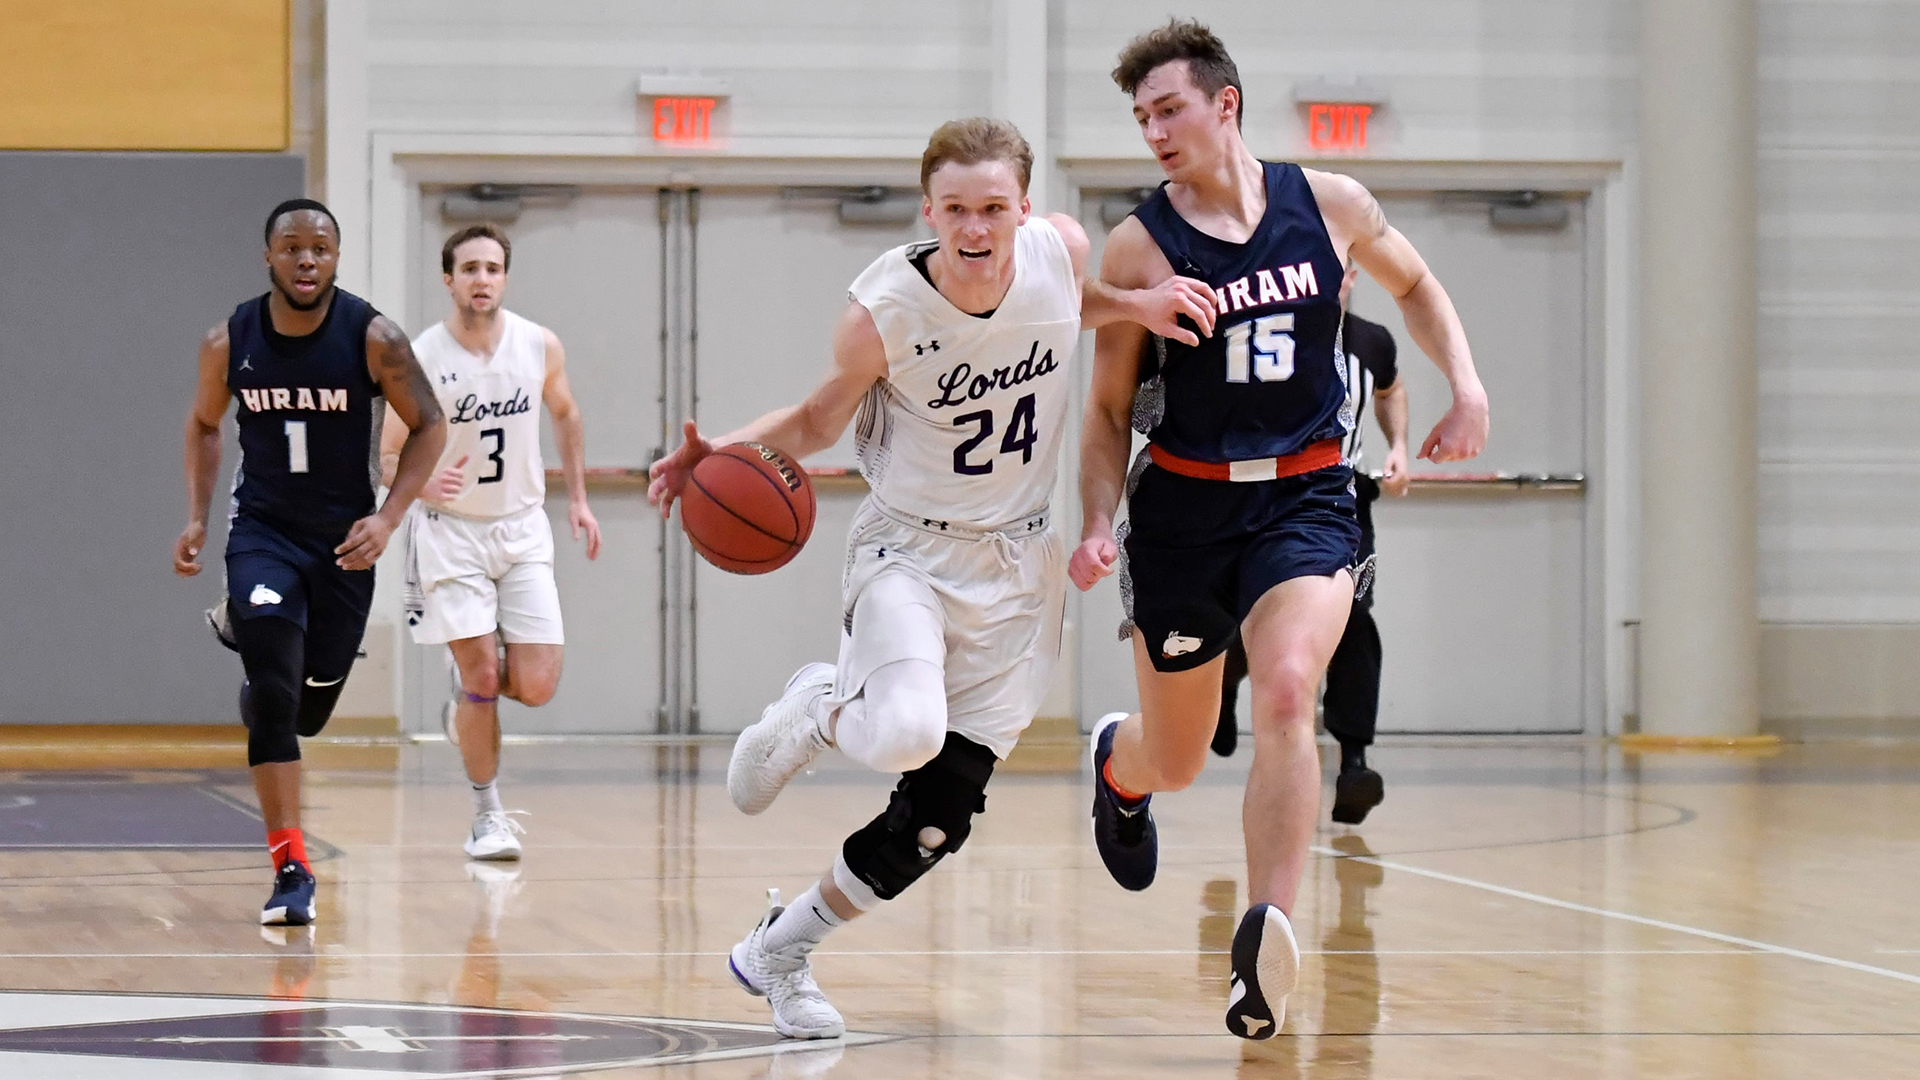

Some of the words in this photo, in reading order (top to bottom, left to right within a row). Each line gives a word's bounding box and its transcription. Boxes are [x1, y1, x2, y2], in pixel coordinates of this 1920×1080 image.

[654, 98, 716, 142] EXIT
[1309, 104, 1371, 149] EXIT
[1215, 261, 1319, 315] IRAM
[927, 340, 1059, 409] Lords
[1223, 312, 1296, 384] 15
[240, 387, 348, 412] HIRAM
[450, 387, 531, 424] Lords
[285, 420, 309, 474] 1
[478, 427, 505, 484] 3
[953, 392, 1038, 475] 24
